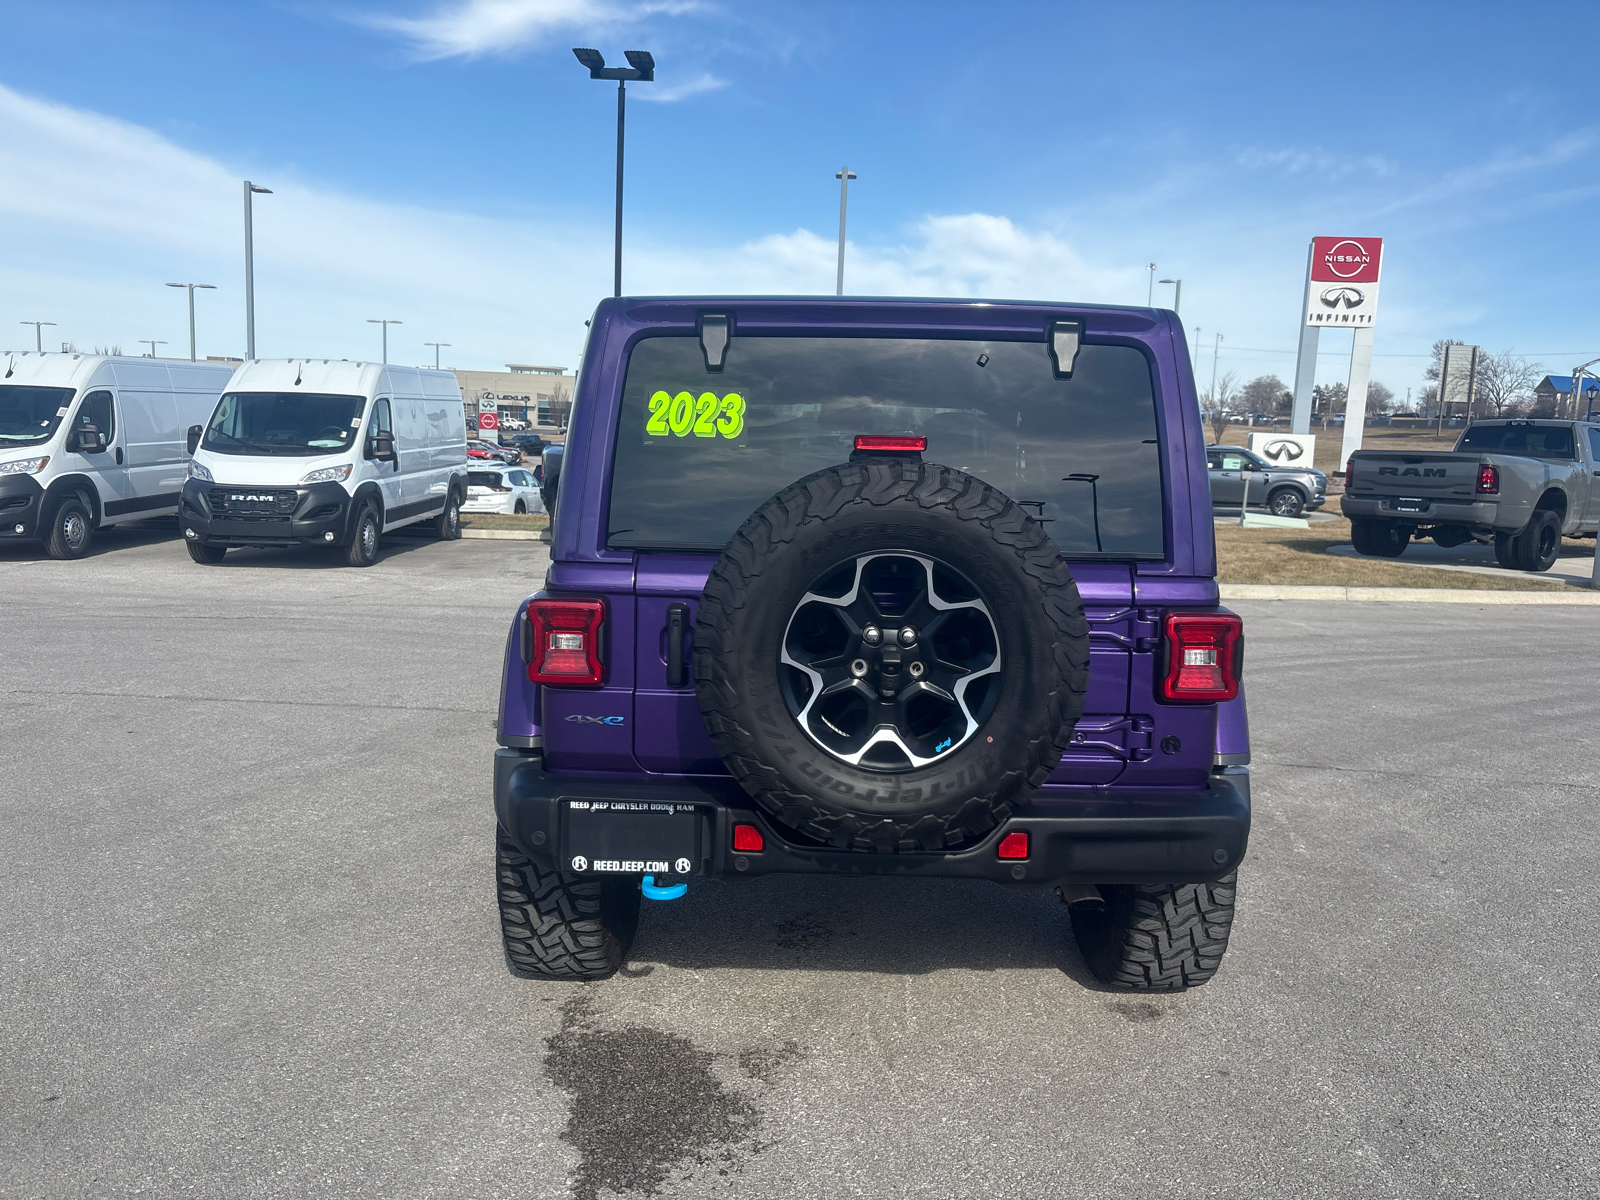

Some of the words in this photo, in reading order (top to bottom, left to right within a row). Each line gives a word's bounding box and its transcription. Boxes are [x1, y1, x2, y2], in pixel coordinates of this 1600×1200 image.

[1325, 255, 1370, 263] NISSAN
[1309, 313, 1372, 323] INFINITI
[646, 390, 746, 439] 2023
[1378, 466, 1447, 478] RAM
[570, 801, 589, 809] REED
[592, 802, 609, 810] JEEP
[611, 802, 649, 810] CHRYSLER
[651, 803, 674, 811] DODGE
[593, 860, 669, 872] REEDJEEP.COM
